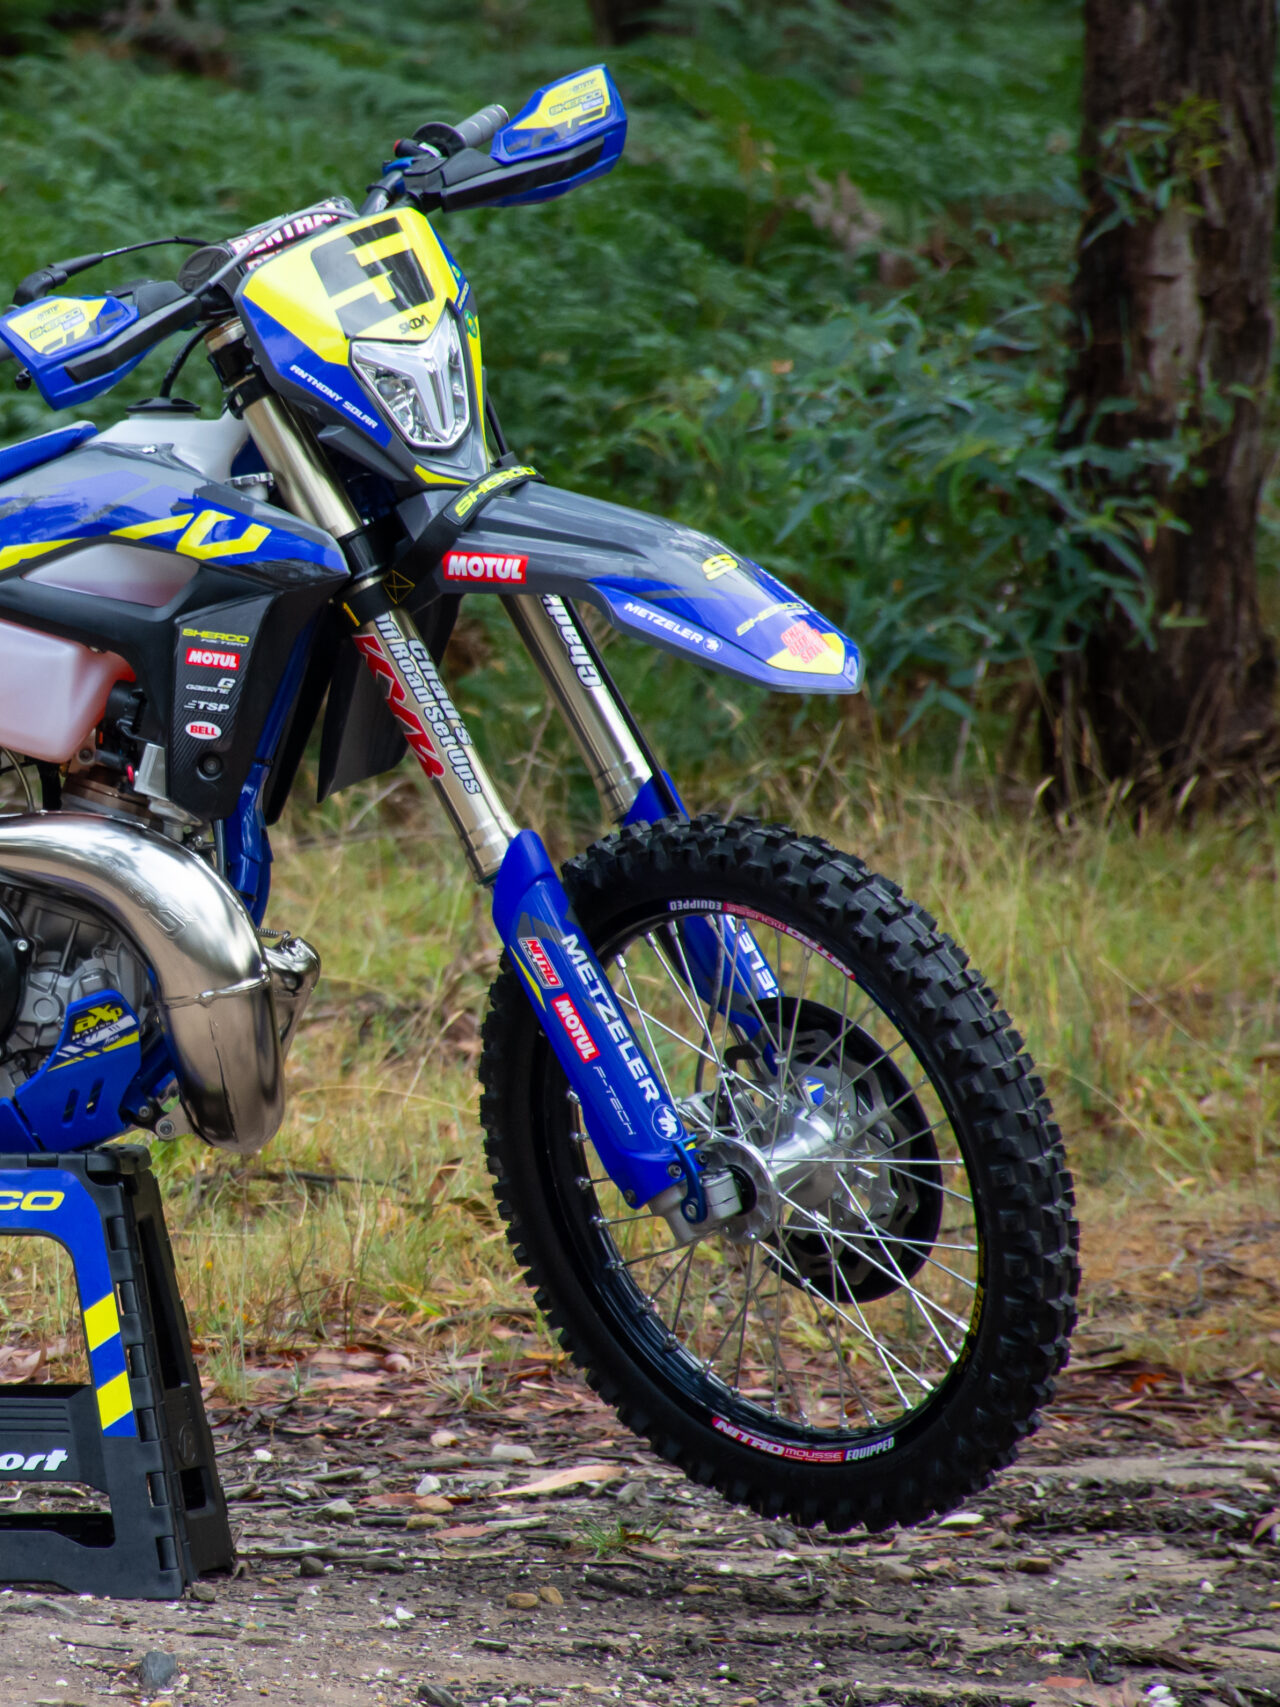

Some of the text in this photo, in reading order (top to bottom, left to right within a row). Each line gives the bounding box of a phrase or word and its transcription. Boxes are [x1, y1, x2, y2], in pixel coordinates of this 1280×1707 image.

[289, 364, 378, 430] ANTHONY SOLAR
[454, 465, 537, 518] SHERCO
[448, 555, 523, 580] MOTUL
[182, 628, 250, 643] SHERCO
[541, 594, 603, 690] Chad'
[623, 602, 704, 644] METZELER
[188, 650, 237, 669] MOTUL
[197, 700, 230, 712] TSP
[387, 642, 436, 704] Road
[423, 705, 458, 748] Set
[447, 749, 483, 795] Ups
[190, 724, 218, 737] BELL
[670, 899, 722, 912] EQUIPPED
[526, 939, 561, 986] NITRO
[555, 999, 596, 1060] MOTUL
[561, 933, 661, 1103] METZELER
[714, 1418, 895, 1462] NITRO MOUSSE EQUIPPED
